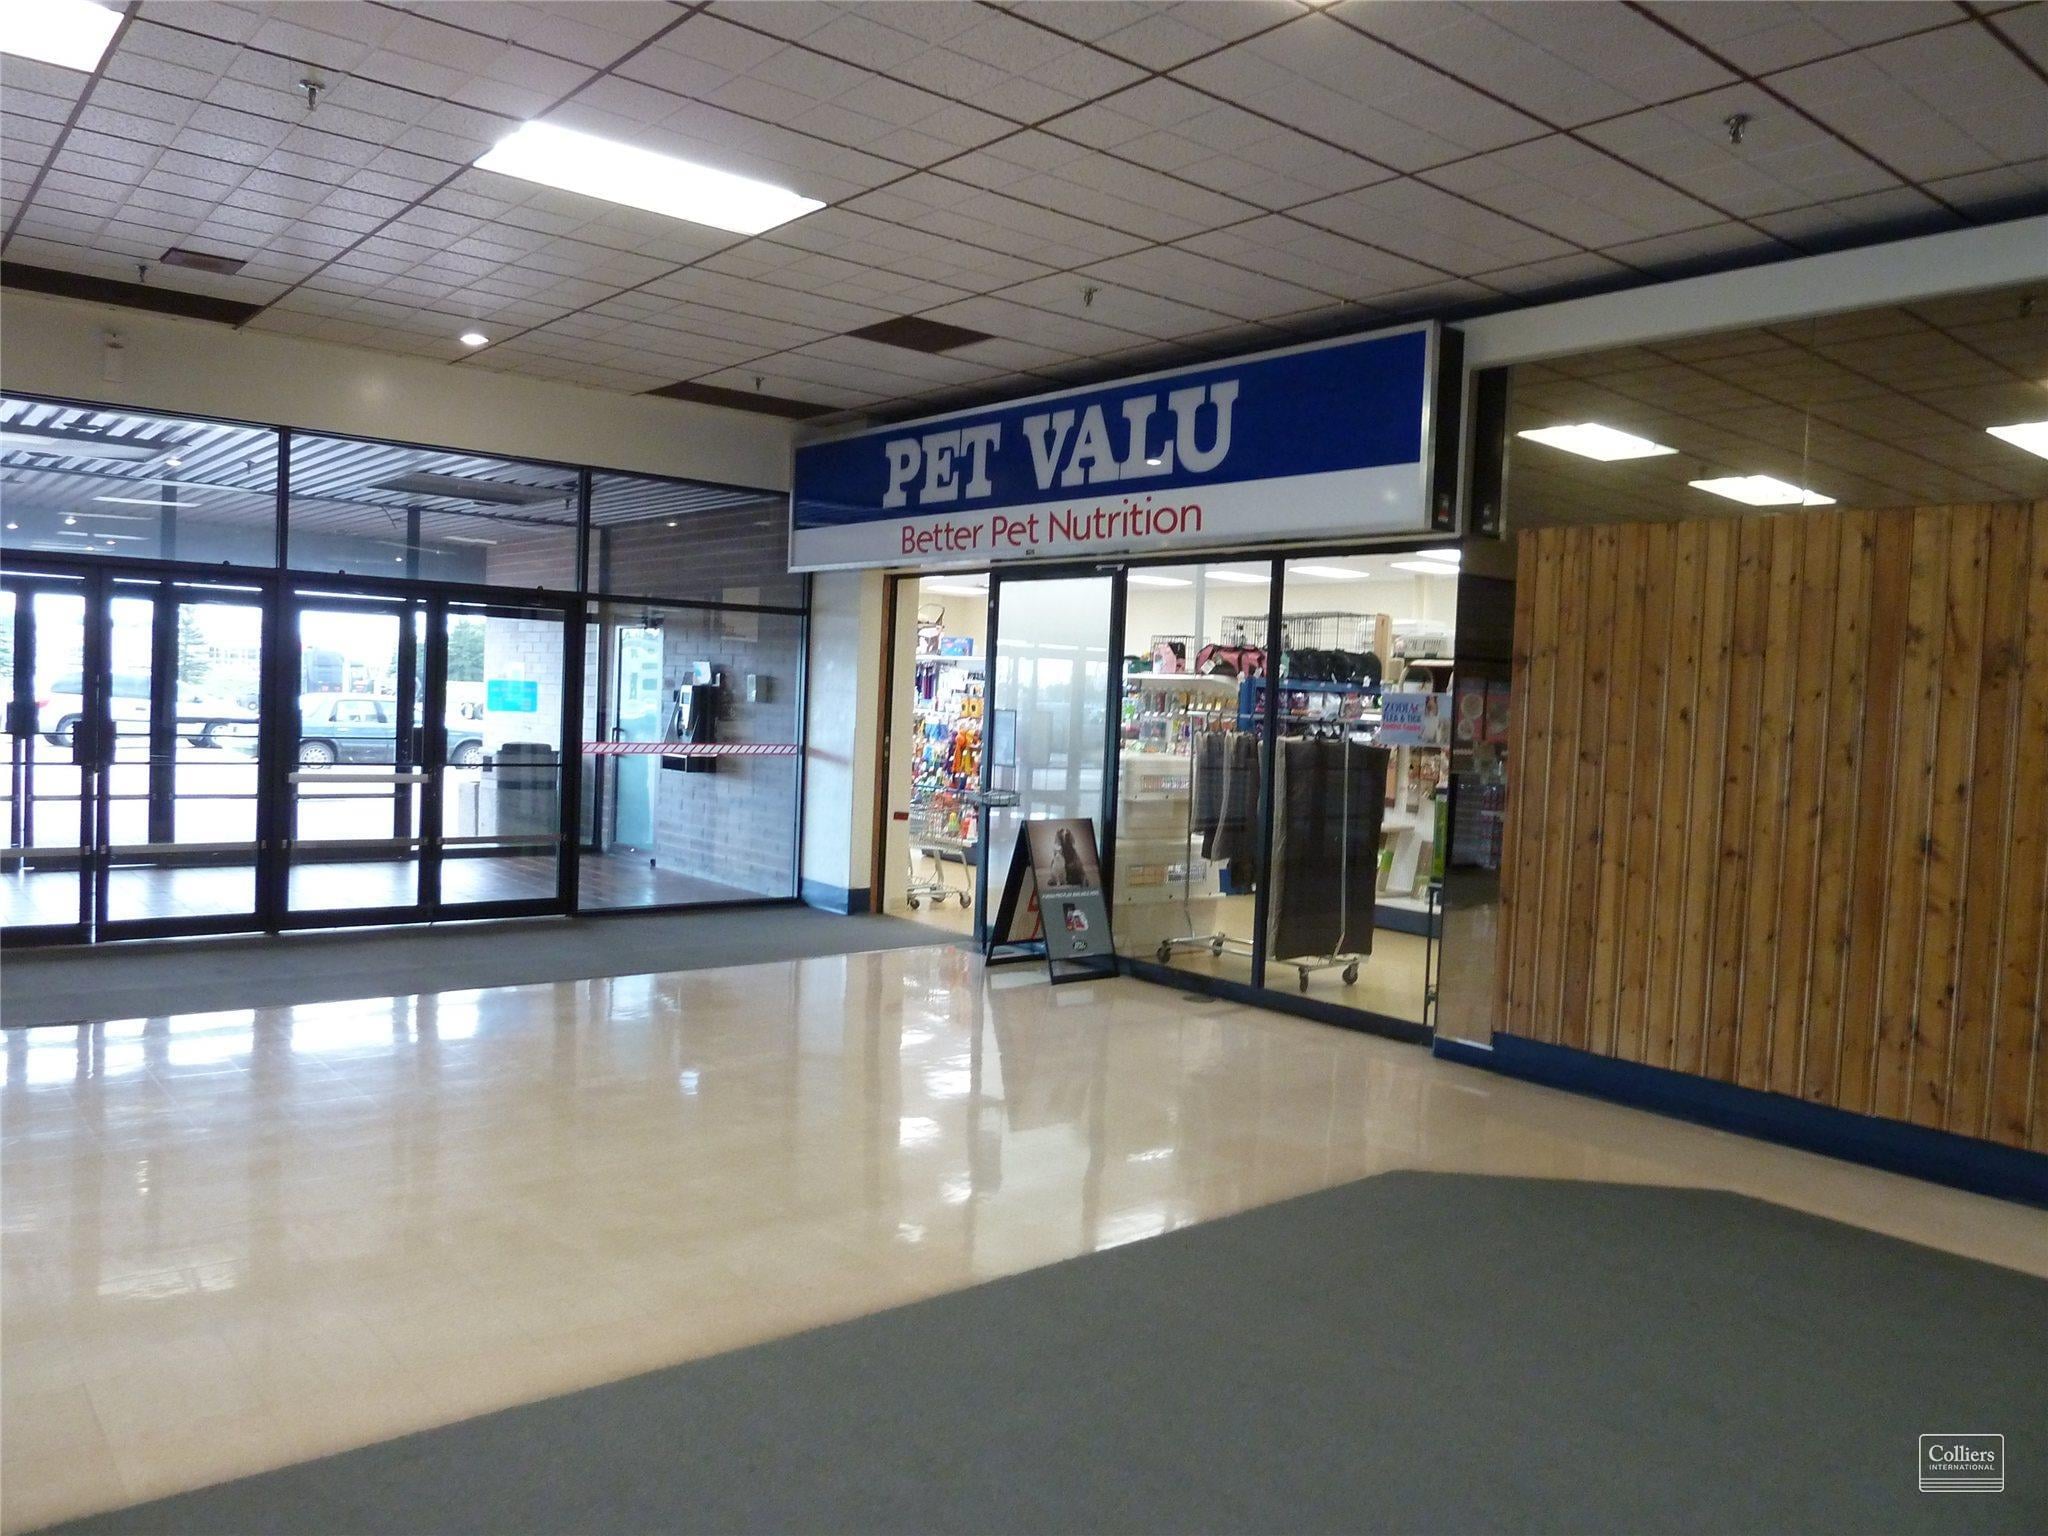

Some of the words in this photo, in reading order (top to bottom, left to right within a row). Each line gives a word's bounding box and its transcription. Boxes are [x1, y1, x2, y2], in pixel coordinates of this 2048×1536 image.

[883, 422, 1001, 509] PET
[1023, 379, 1239, 490] VALU
[902, 523, 984, 554] Better
[992, 513, 1039, 547] Pet
[1049, 497, 1202, 544] Nutrition
